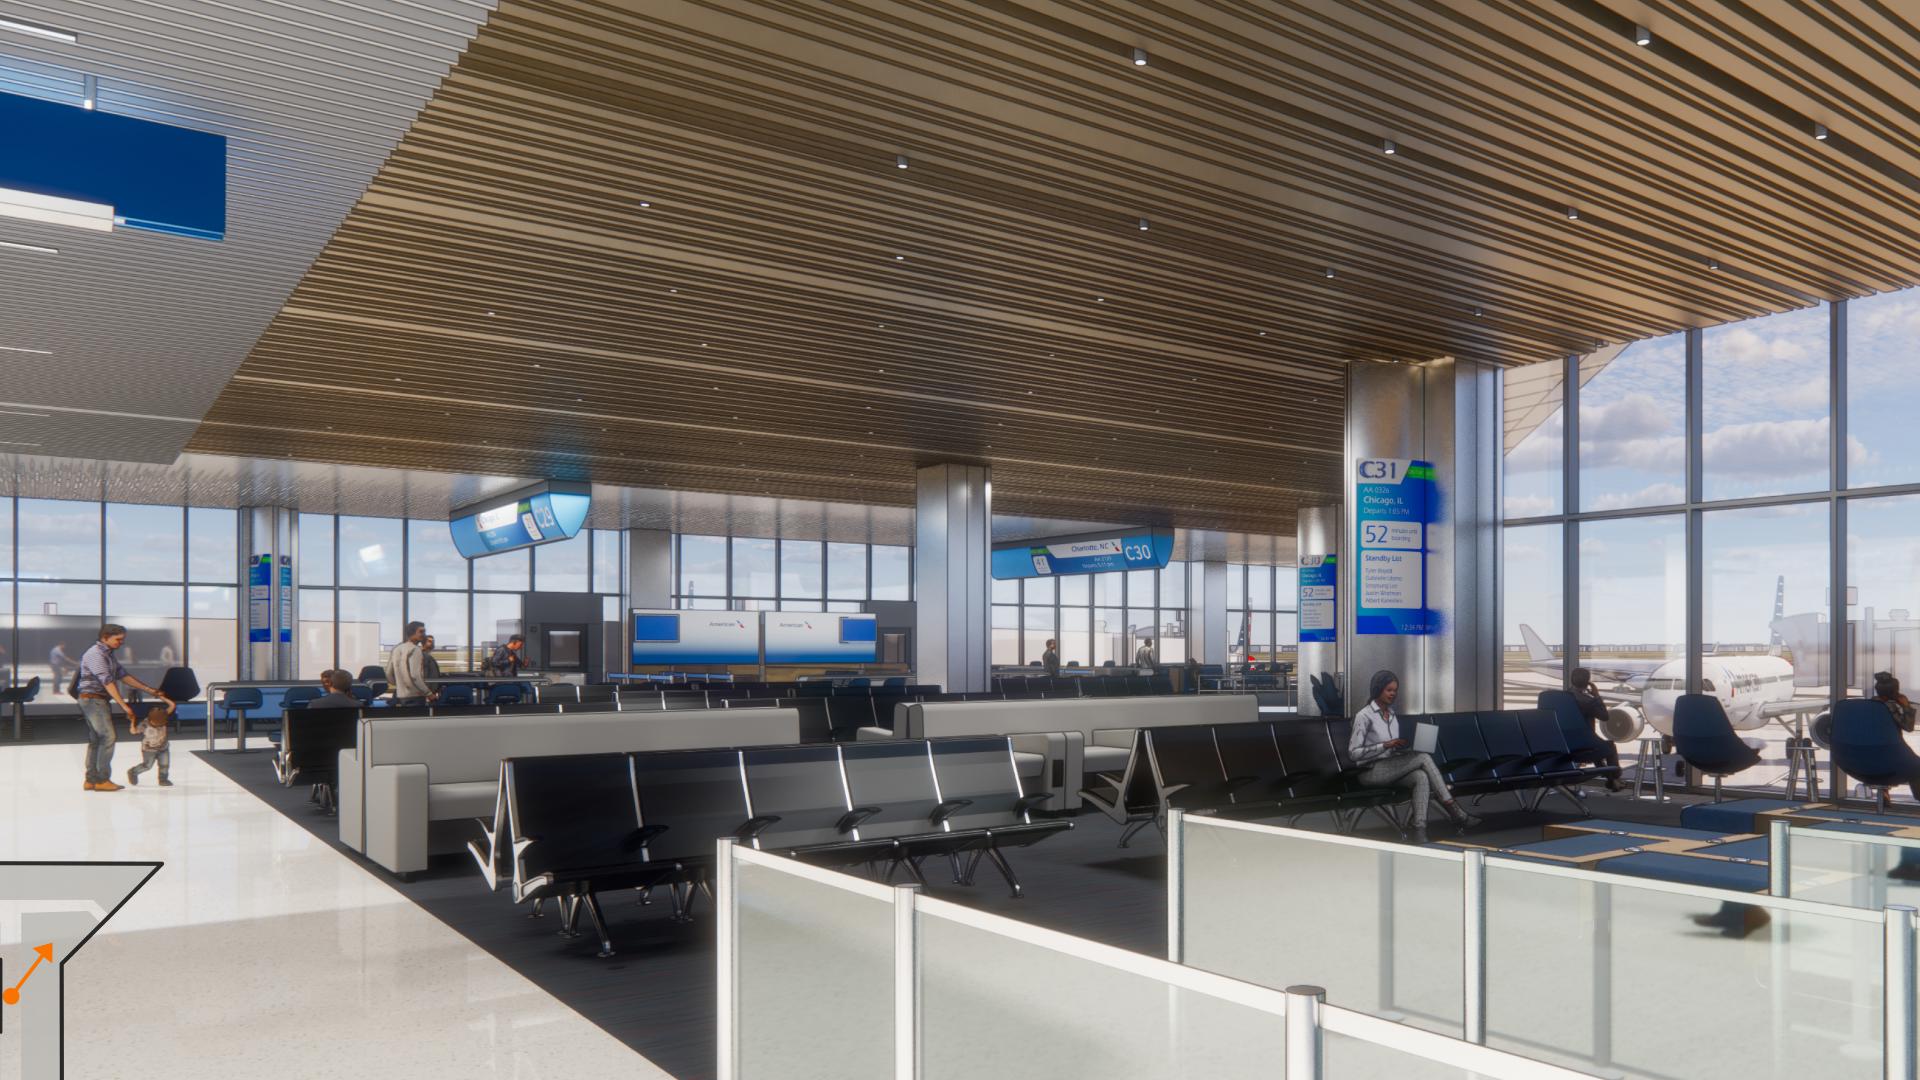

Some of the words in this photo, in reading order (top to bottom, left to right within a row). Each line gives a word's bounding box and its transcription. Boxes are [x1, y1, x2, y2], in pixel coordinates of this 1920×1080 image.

[1359, 460, 1396, 479] C31
[1363, 495, 1396, 505] Chicago,
[1365, 525, 1388, 543] 52
[1099, 542, 1109, 550] NC
[1125, 544, 1151, 561] C30
